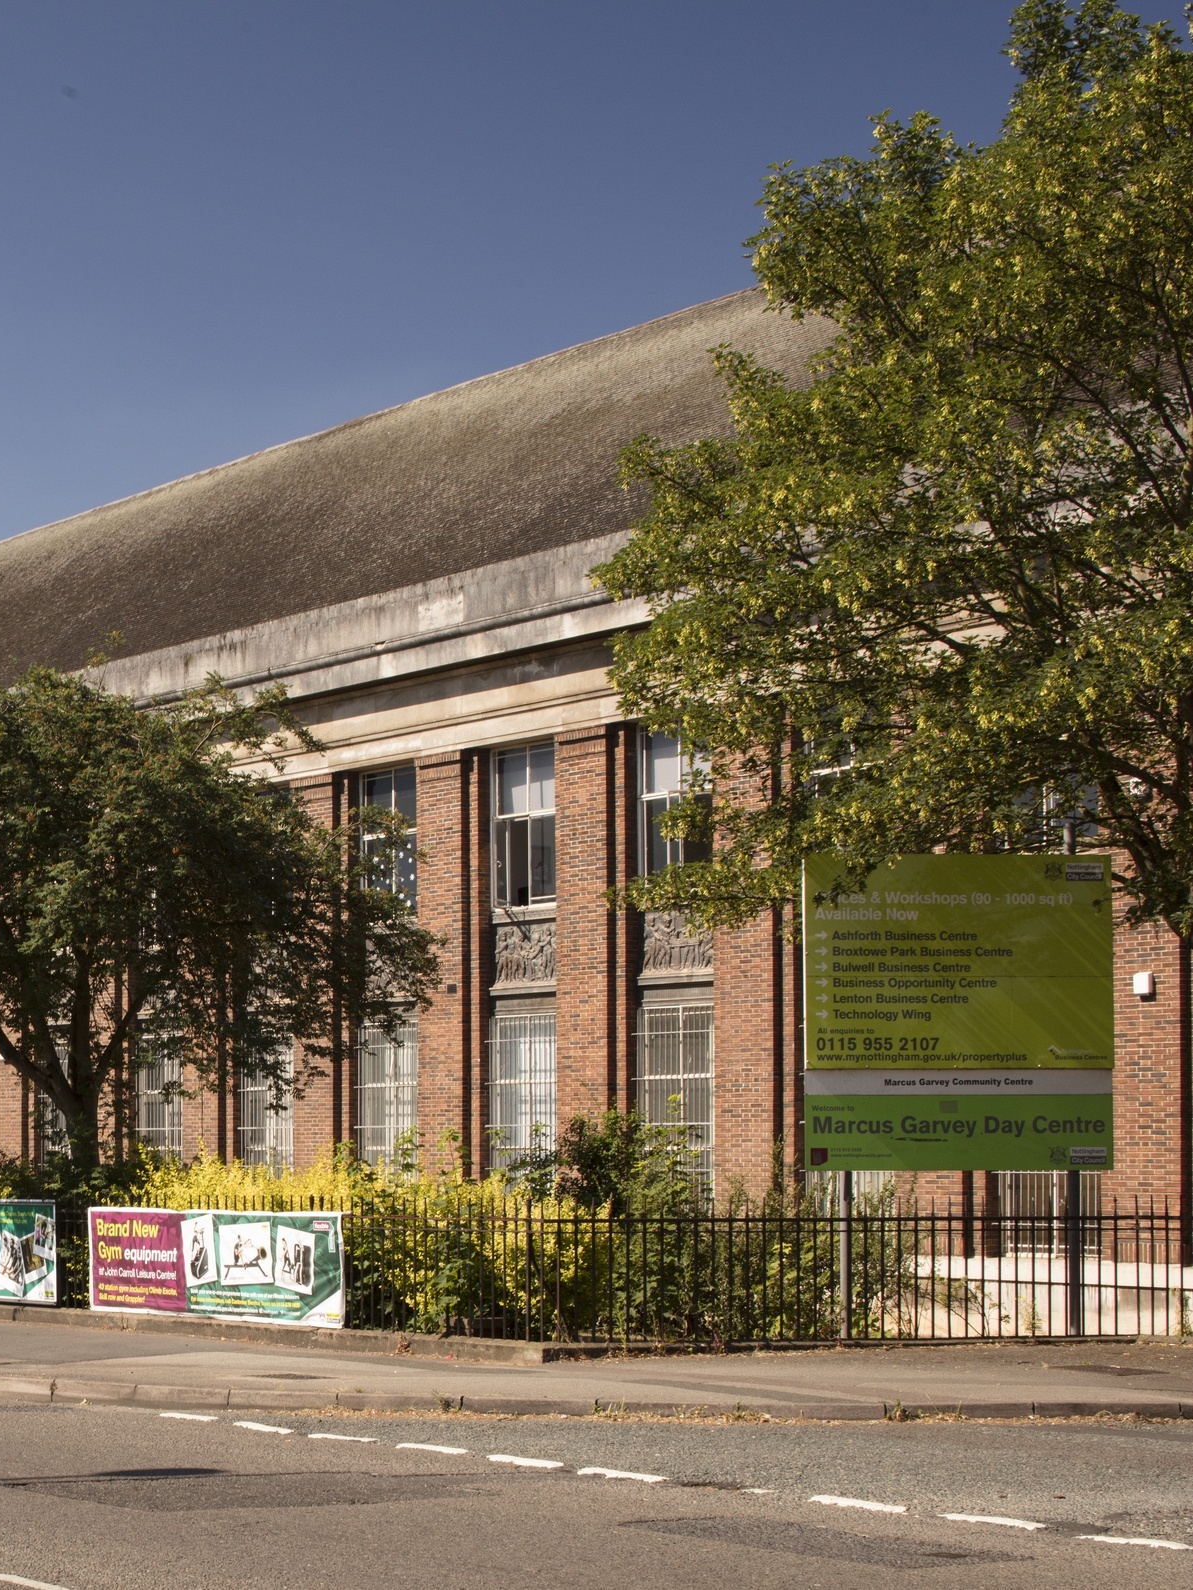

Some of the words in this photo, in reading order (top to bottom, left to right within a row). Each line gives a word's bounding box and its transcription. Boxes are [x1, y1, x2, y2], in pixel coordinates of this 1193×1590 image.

[1067, 873, 1079, 881] City
[821, 891, 866, 904] ices
[870, 891, 881, 904] &
[884, 891, 968, 907] Workshops
[971, 891, 992, 906] (90
[1005, 892, 1036, 905] 1000
[1039, 894, 1055, 906] sq
[1058, 891, 1073, 906] ft)
[814, 907, 882, 920] Available
[885, 907, 919, 920] Now
[832, 930, 881, 941] Ashforth
[885, 930, 937, 941] Business
[939, 930, 977, 941] Centre
[832, 946, 887, 957] Broxtowe
[890, 946, 917, 957] Park
[920, 946, 972, 957] Business
[975, 946, 1013, 957] Centre
[832, 962, 874, 972] Bulwell
[878, 962, 930, 972] Business
[933, 962, 971, 972] Centre
[833, 978, 885, 988] Business
[888, 977, 956, 990] Opportunity
[959, 978, 997, 988] Centre
[833, 993, 872, 1004] Lenton
[876, 993, 928, 1004] Business
[930, 993, 969, 1004] Centre
[833, 1009, 901, 1021] Technology
[902, 1009, 932, 1021] Wing
[830, 1028, 864, 1036] enquiries
[816, 1037, 857, 1051] 0115
[862, 1037, 893, 1051] 955
[898, 1037, 940, 1051] 2107
[817, 1052, 1027, 1062] www.mynottingham.gov.uk/propertyplus
[918, 1078, 949, 1087] Garvey
[952, 1078, 1002, 1087] Community
[1004, 1078, 1033, 1086] Centre
[812, 1116, 894, 1134] Marcus
[901, 1115, 977, 1138] Garvey
[984, 1116, 1025, 1138] Day
[1032, 1115, 1106, 1134] Centre
[96, 1219, 130, 1237] Brand
[132, 1220, 159, 1238] New
[98, 1241, 122, 1263] Gym
[124, 1245, 177, 1264] equipment
[99, 1267, 104, 1276] at
[105, 1267, 118, 1276] John
[119, 1268, 135, 1278] Carroll
[136, 1269, 155, 1279] Leisure
[156, 1270, 177, 1280] Centre!
[119, 1285, 129, 1293] gym
[129, 1285, 149, 1295] including
[149, 1287, 162, 1295] Climb
